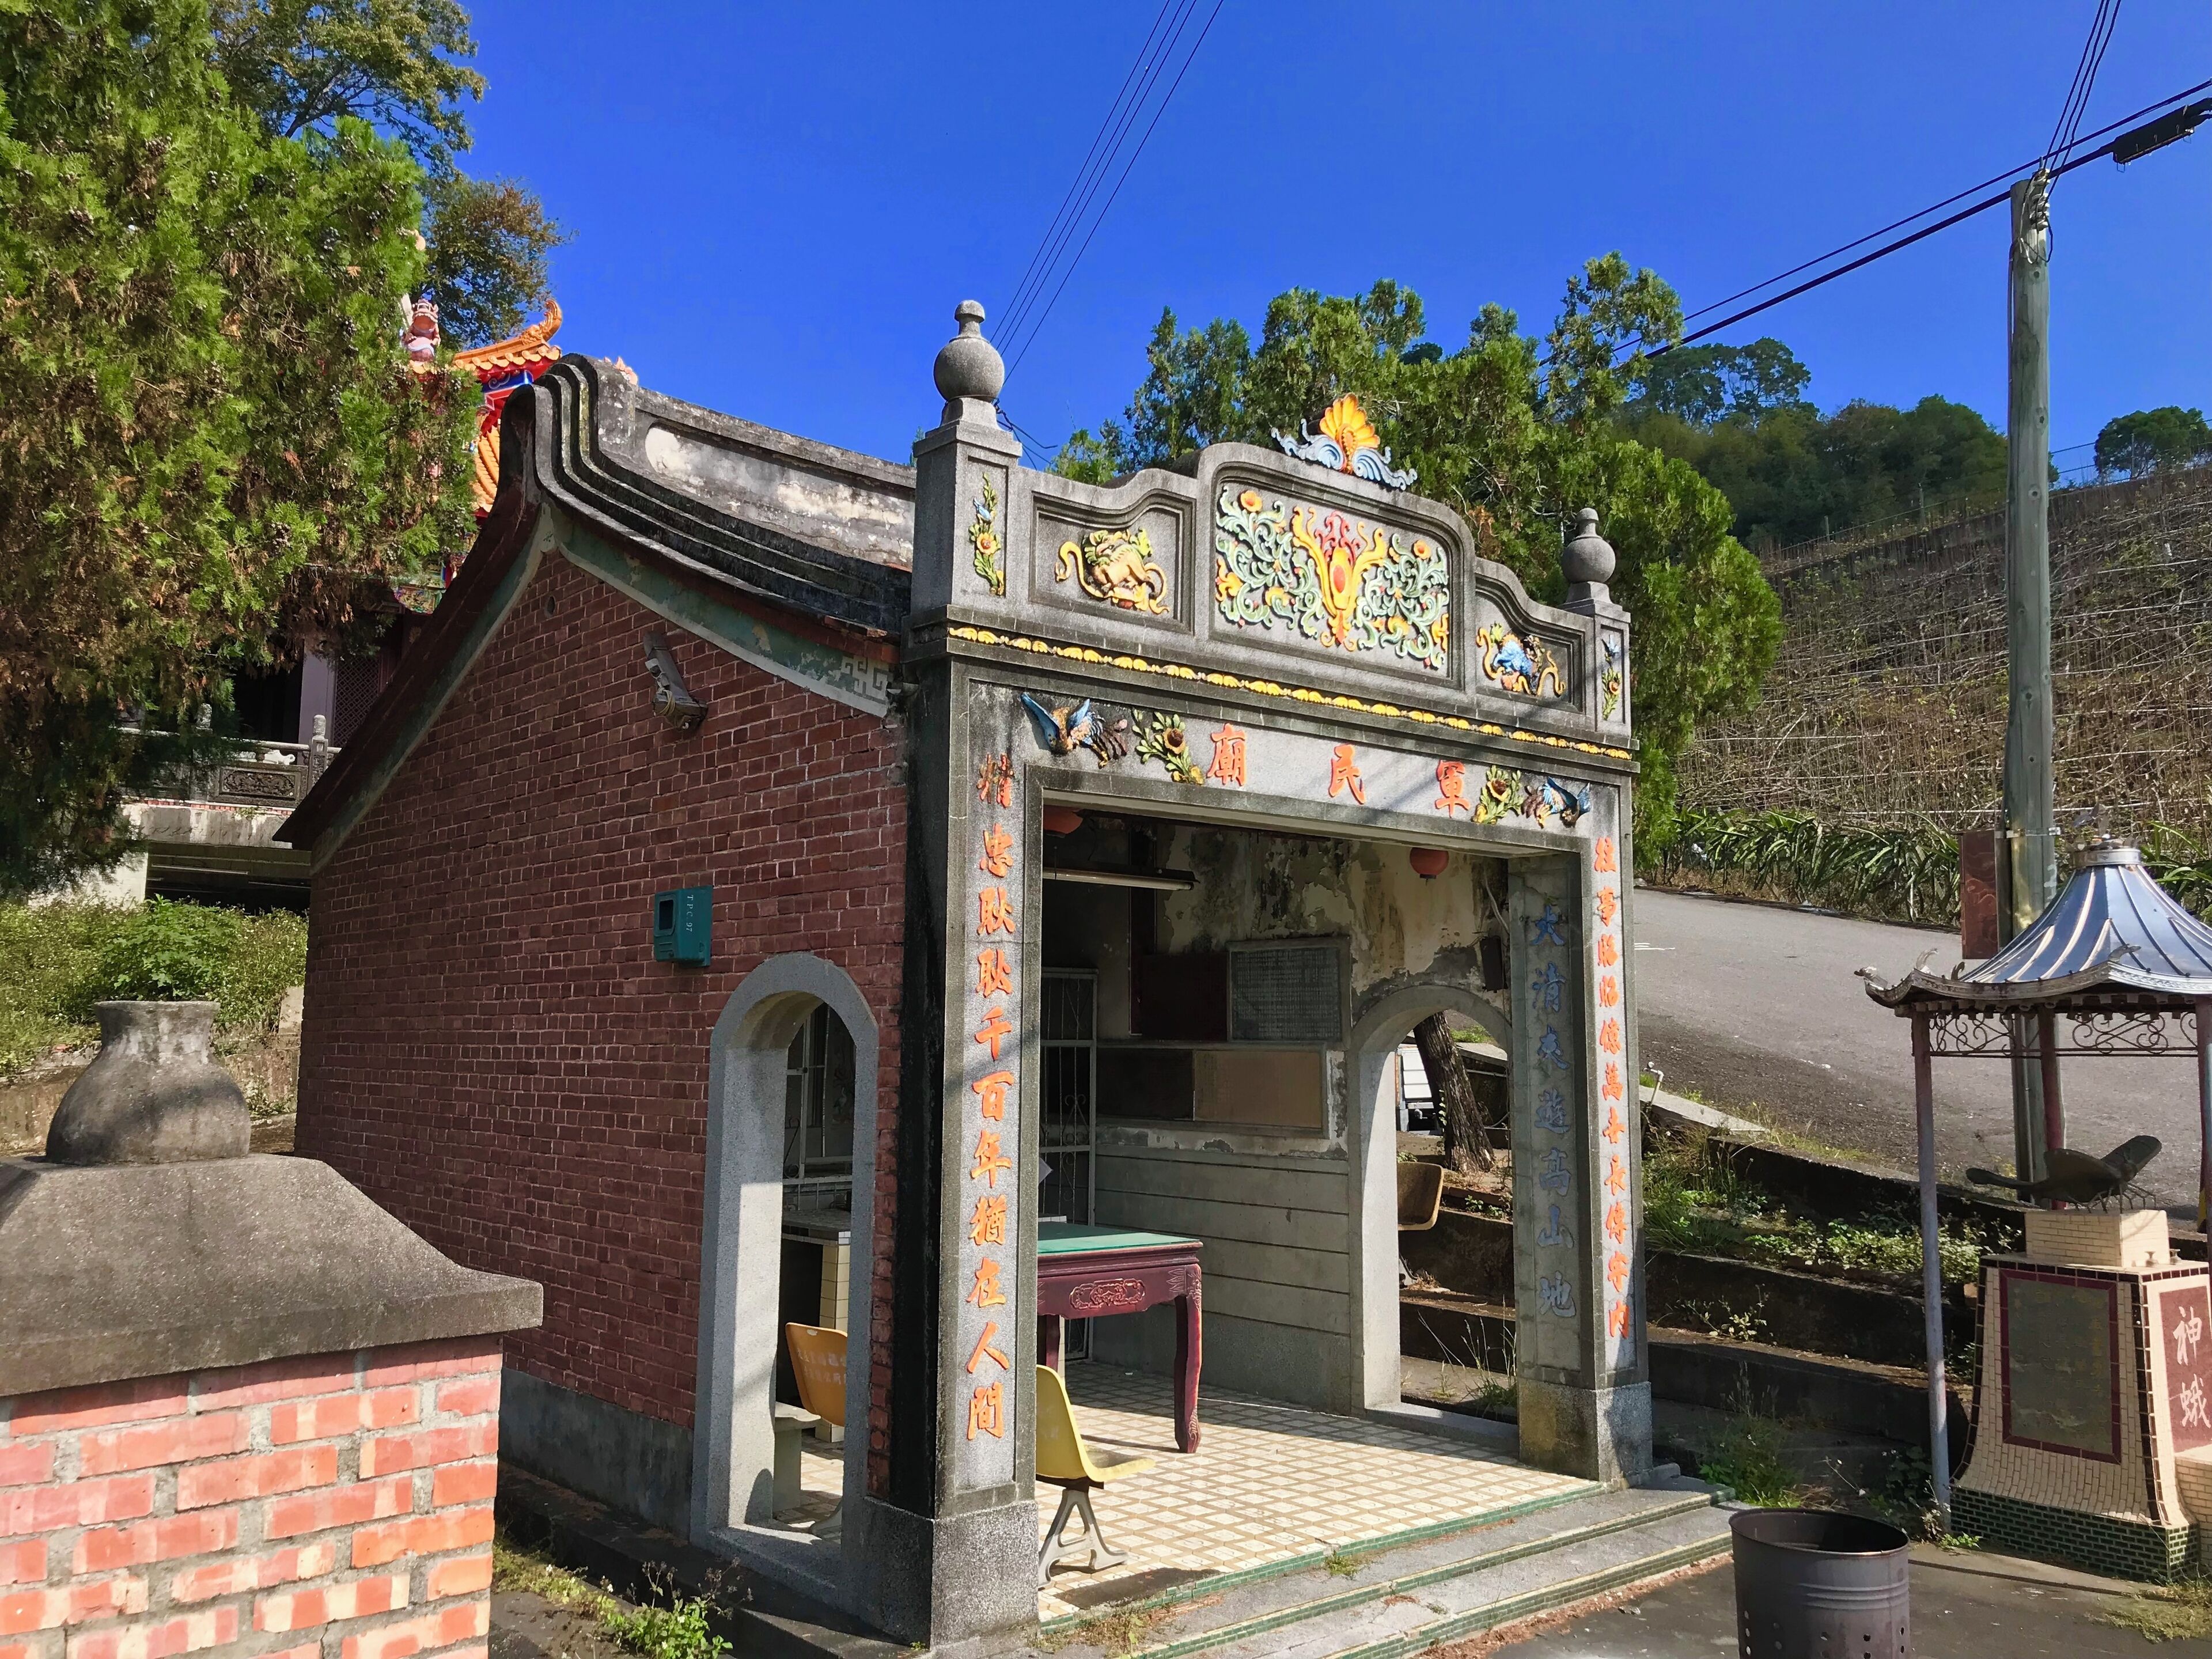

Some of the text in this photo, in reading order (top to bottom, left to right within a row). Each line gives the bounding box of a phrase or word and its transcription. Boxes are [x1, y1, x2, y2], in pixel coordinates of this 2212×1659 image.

[1206, 722, 1471, 819] 軍民廟
[2172, 1305, 2211, 1429] 神蛾
